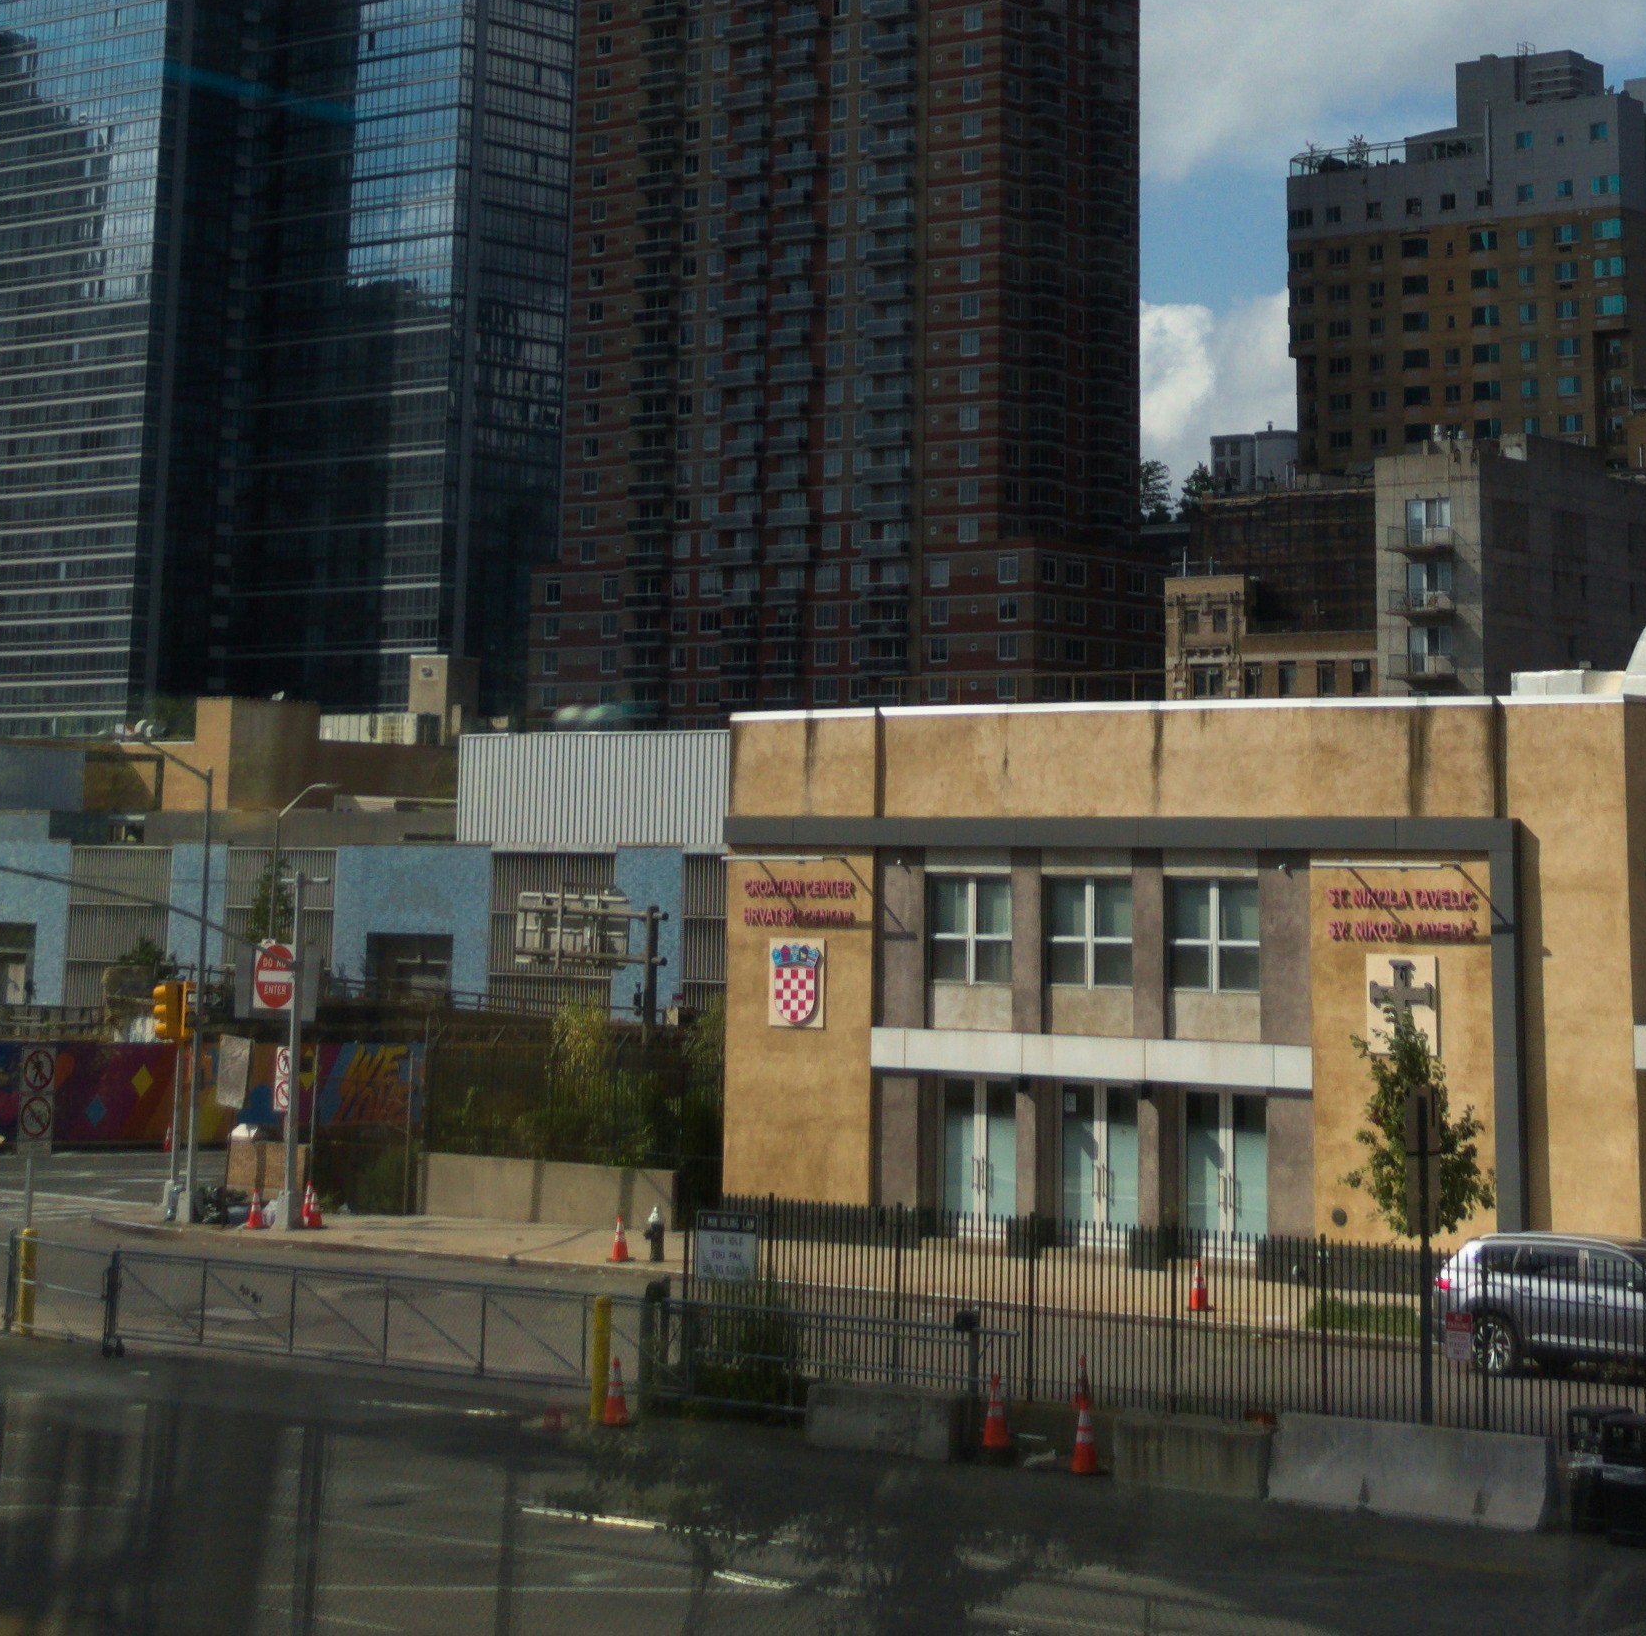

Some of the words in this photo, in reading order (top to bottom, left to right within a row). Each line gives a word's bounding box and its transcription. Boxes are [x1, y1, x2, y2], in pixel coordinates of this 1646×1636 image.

[805, 880, 853, 897] CENTER
[1352, 887, 1410, 907] NIKOLA
[1355, 920, 1410, 941] NIKOLA
[262, 957, 273, 968] DO
[263, 984, 287, 996] ENTER
[345, 1043, 408, 1079] WE
